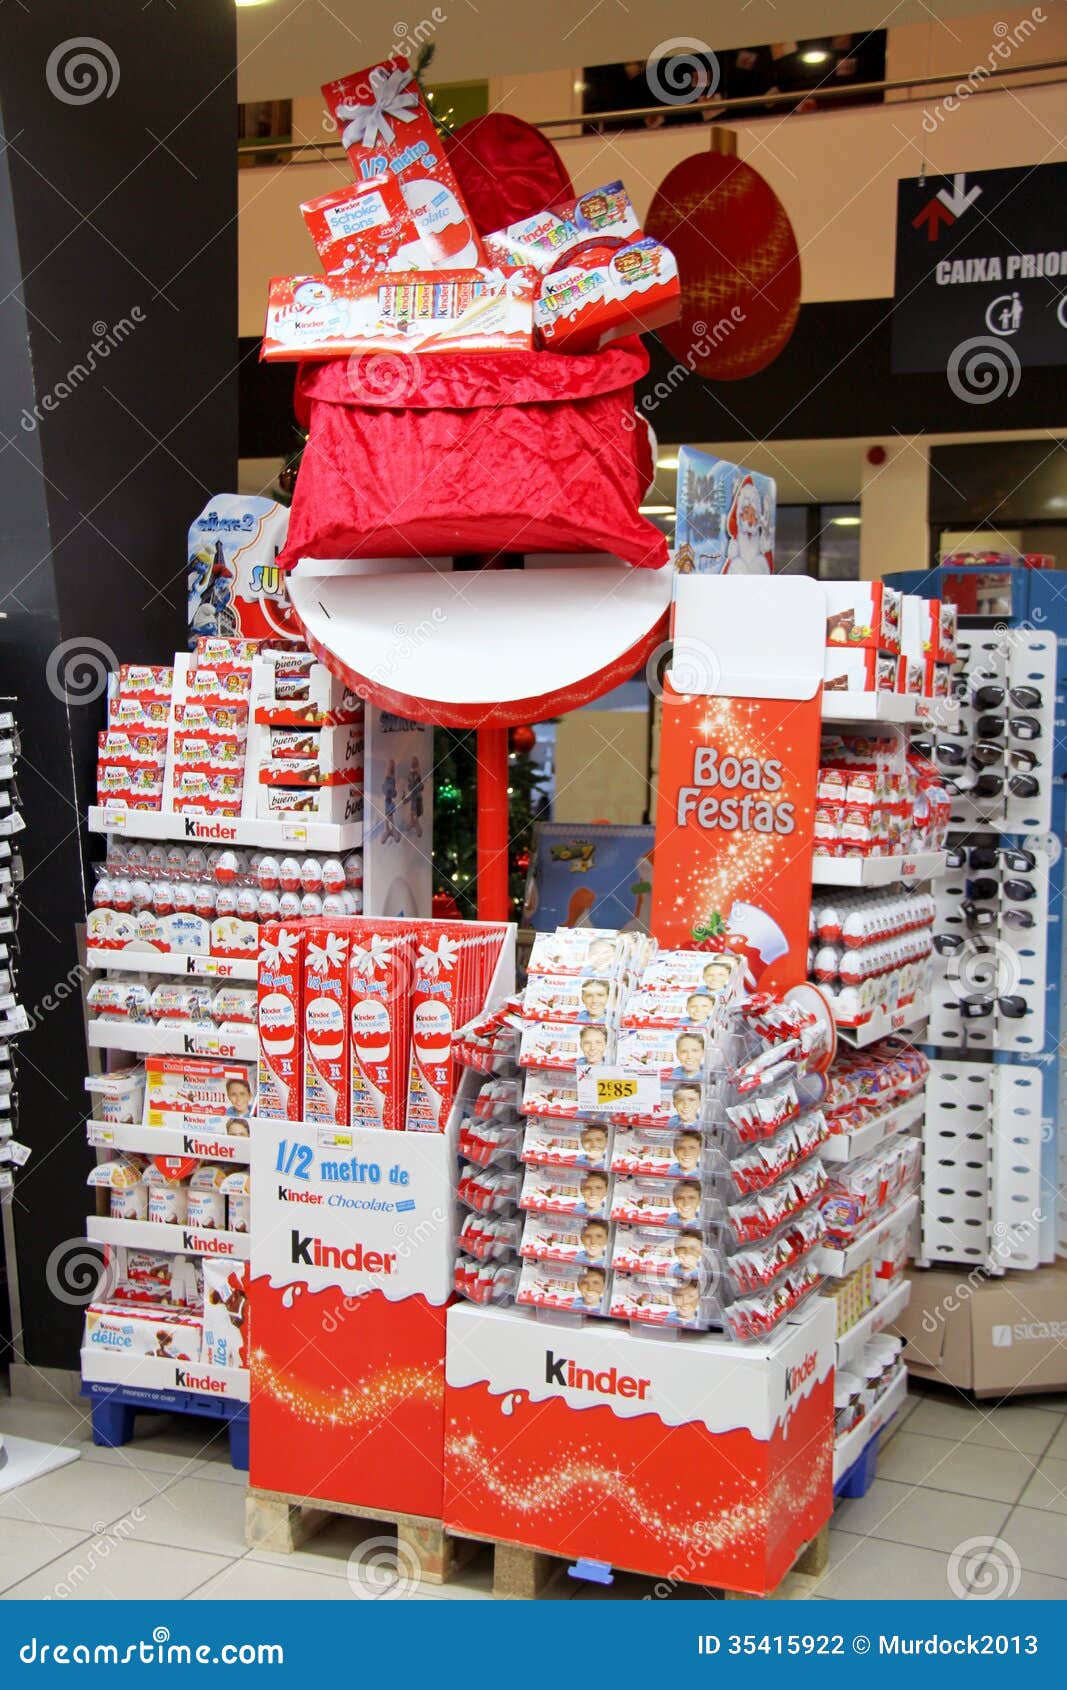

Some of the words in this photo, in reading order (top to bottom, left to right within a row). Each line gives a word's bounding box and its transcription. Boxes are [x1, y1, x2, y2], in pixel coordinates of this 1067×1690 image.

[390, 140, 430, 175] metro
[343, 217, 375, 235] Bons
[935, 257, 1001, 286] CAIXA
[539, 272, 606, 315] SURPRESA
[275, 658, 303, 670] bueno
[276, 683, 296, 694] ueno
[272, 734, 299, 747] bueno
[694, 747, 783, 792] Boas
[271, 794, 298, 806] bueno
[676, 788, 796, 834] Festas
[275, 1139, 313, 1181] 1/2
[320, 1157, 380, 1184] metro
[389, 1165, 410, 1186] de
[327, 1194, 394, 1212] Chocolate
[91, 1330, 133, 1348] délice
[123, 1389, 151, 1399] PROPERTY
